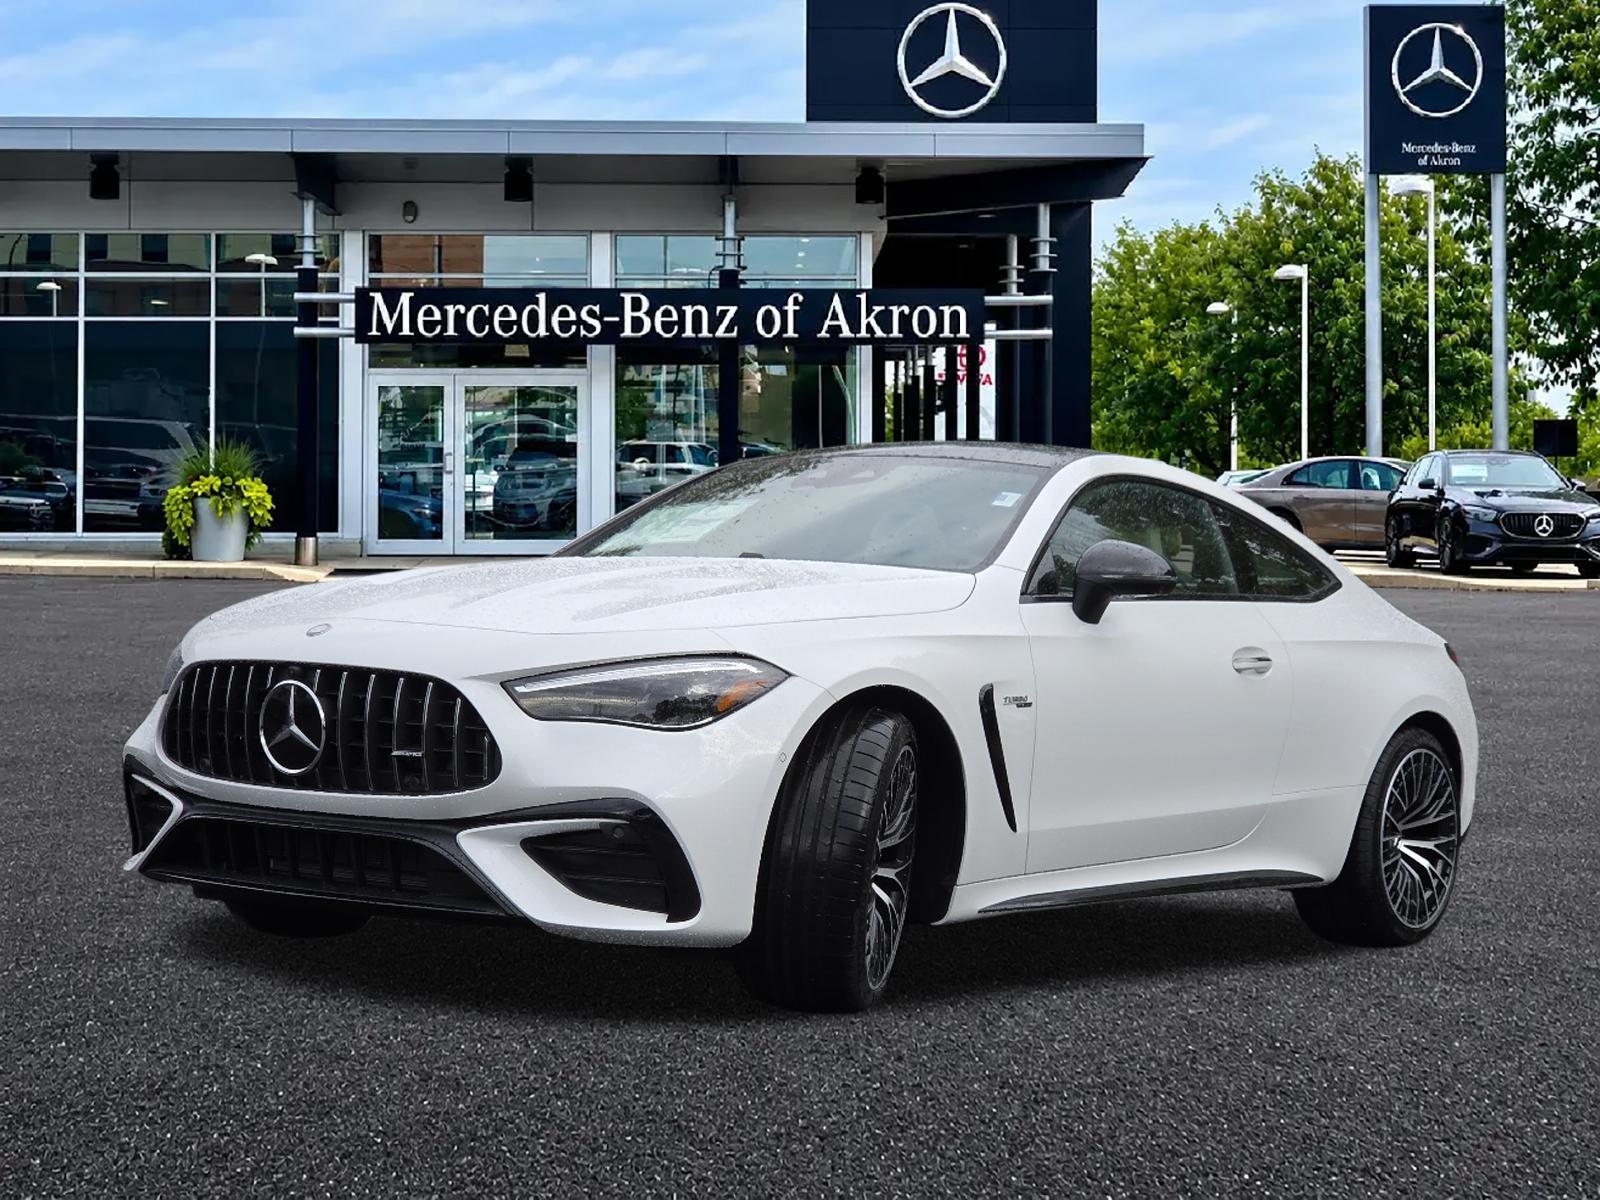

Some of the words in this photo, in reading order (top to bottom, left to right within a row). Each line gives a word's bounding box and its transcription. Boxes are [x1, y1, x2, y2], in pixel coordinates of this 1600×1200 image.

[1401, 141, 1476, 153] Mercedes-Benz
[1418, 154, 1428, 166] of
[1430, 154, 1461, 166] Akron
[367, 291, 738, 338] Mercedes-Benz
[755, 292, 804, 338] of
[817, 292, 970, 338] Akron
